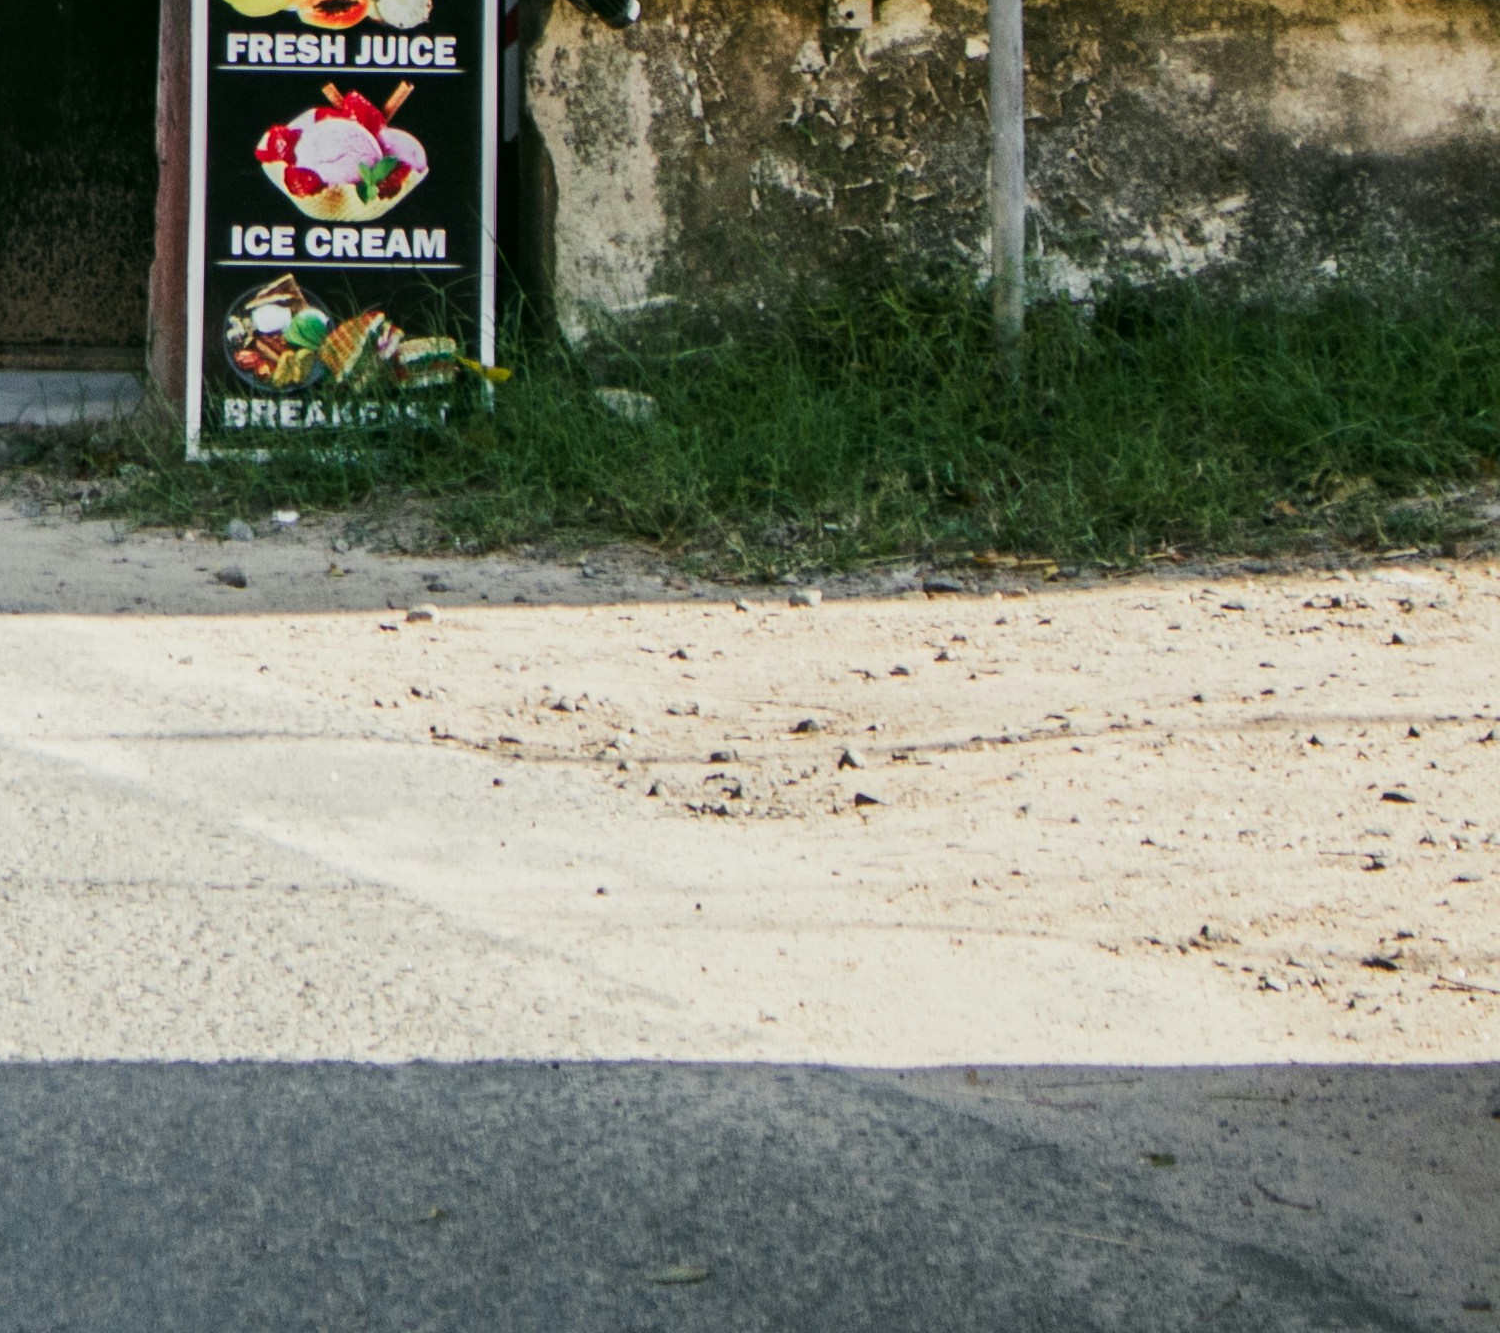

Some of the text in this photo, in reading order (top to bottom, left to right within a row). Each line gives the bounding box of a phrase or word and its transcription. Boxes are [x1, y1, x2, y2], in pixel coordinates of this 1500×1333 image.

[226, 32, 458, 67] FRESH JUICE
[230, 223, 448, 260] ICE CREAM
